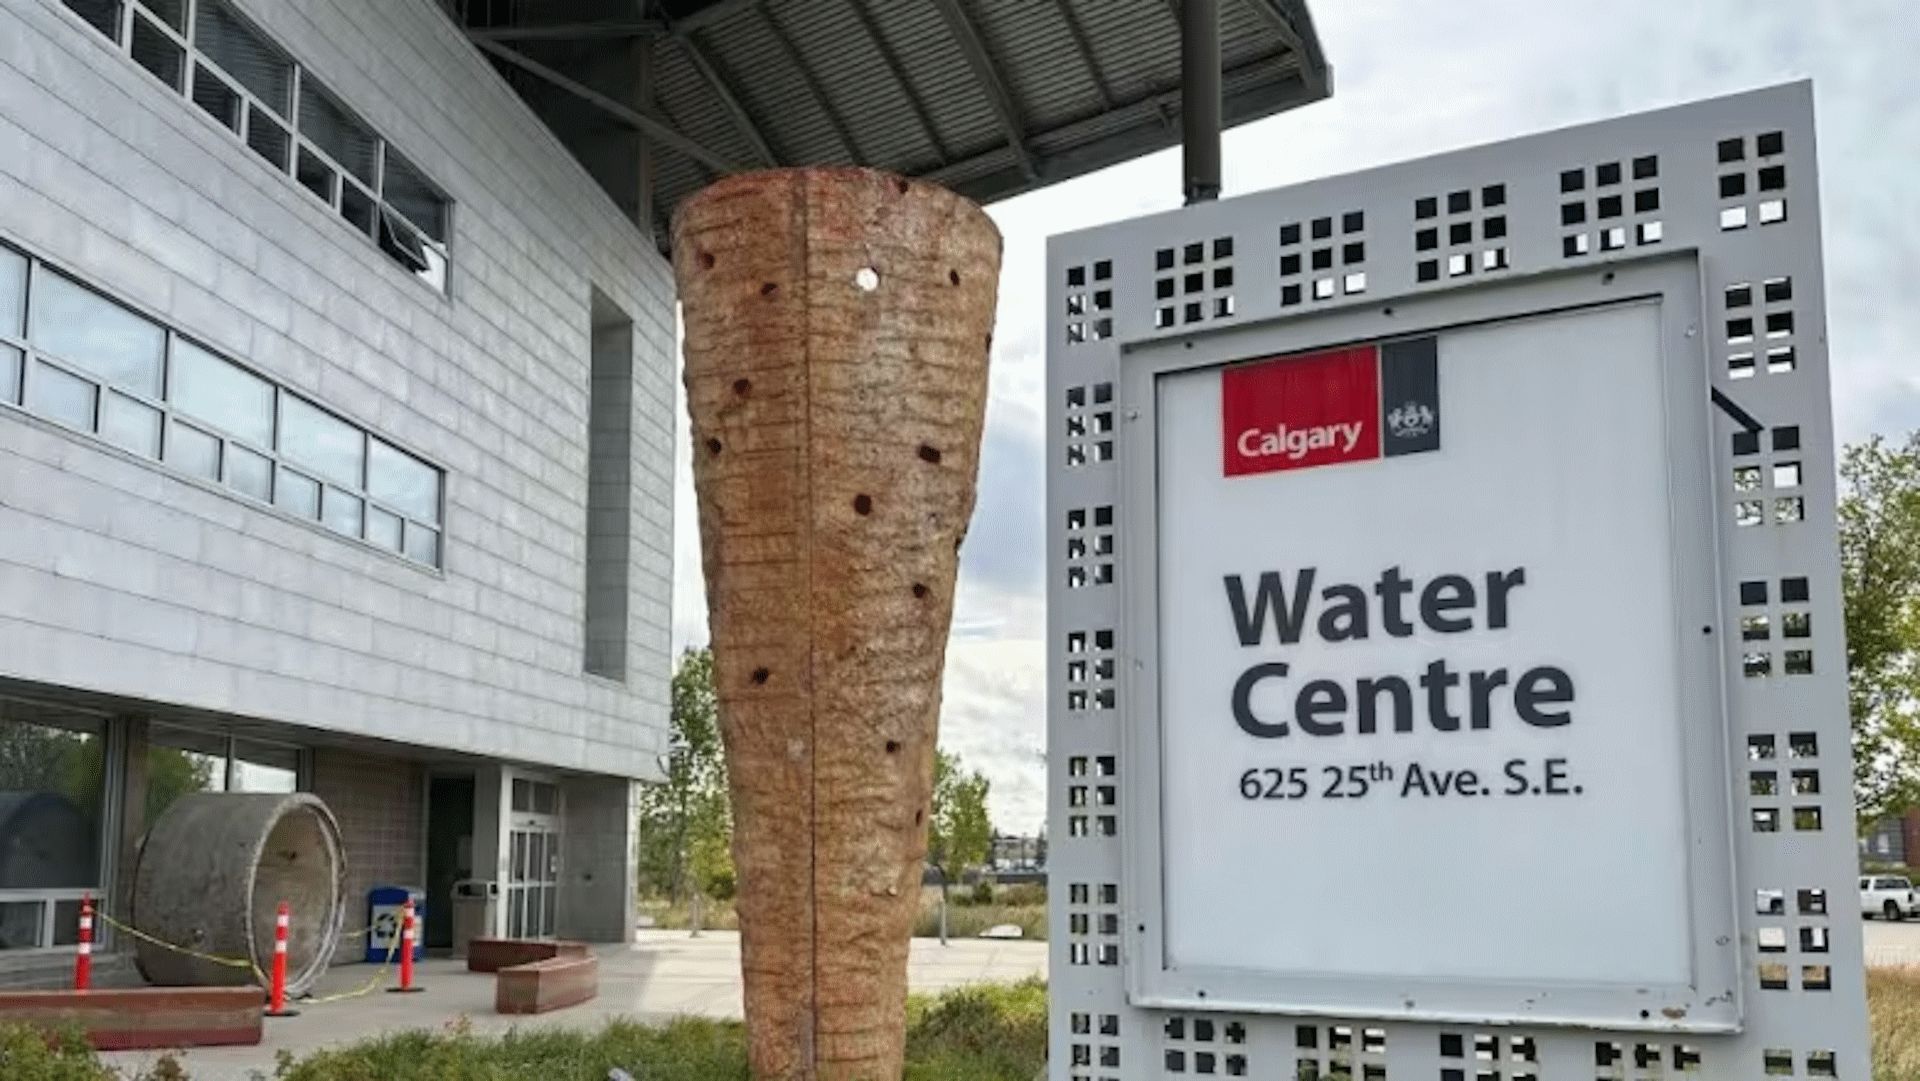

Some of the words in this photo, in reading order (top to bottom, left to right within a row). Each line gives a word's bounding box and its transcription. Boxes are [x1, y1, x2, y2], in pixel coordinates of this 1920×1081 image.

[1237, 420, 1363, 461] Calgary
[1223, 564, 1526, 648] Water
[1230, 657, 1575, 740] Centre
[1239, 766, 1308, 800] 625
[1321, 760, 1394, 799] 25th
[1400, 761, 1490, 798] Ave.
[1504, 758, 1584, 796] S.E.
